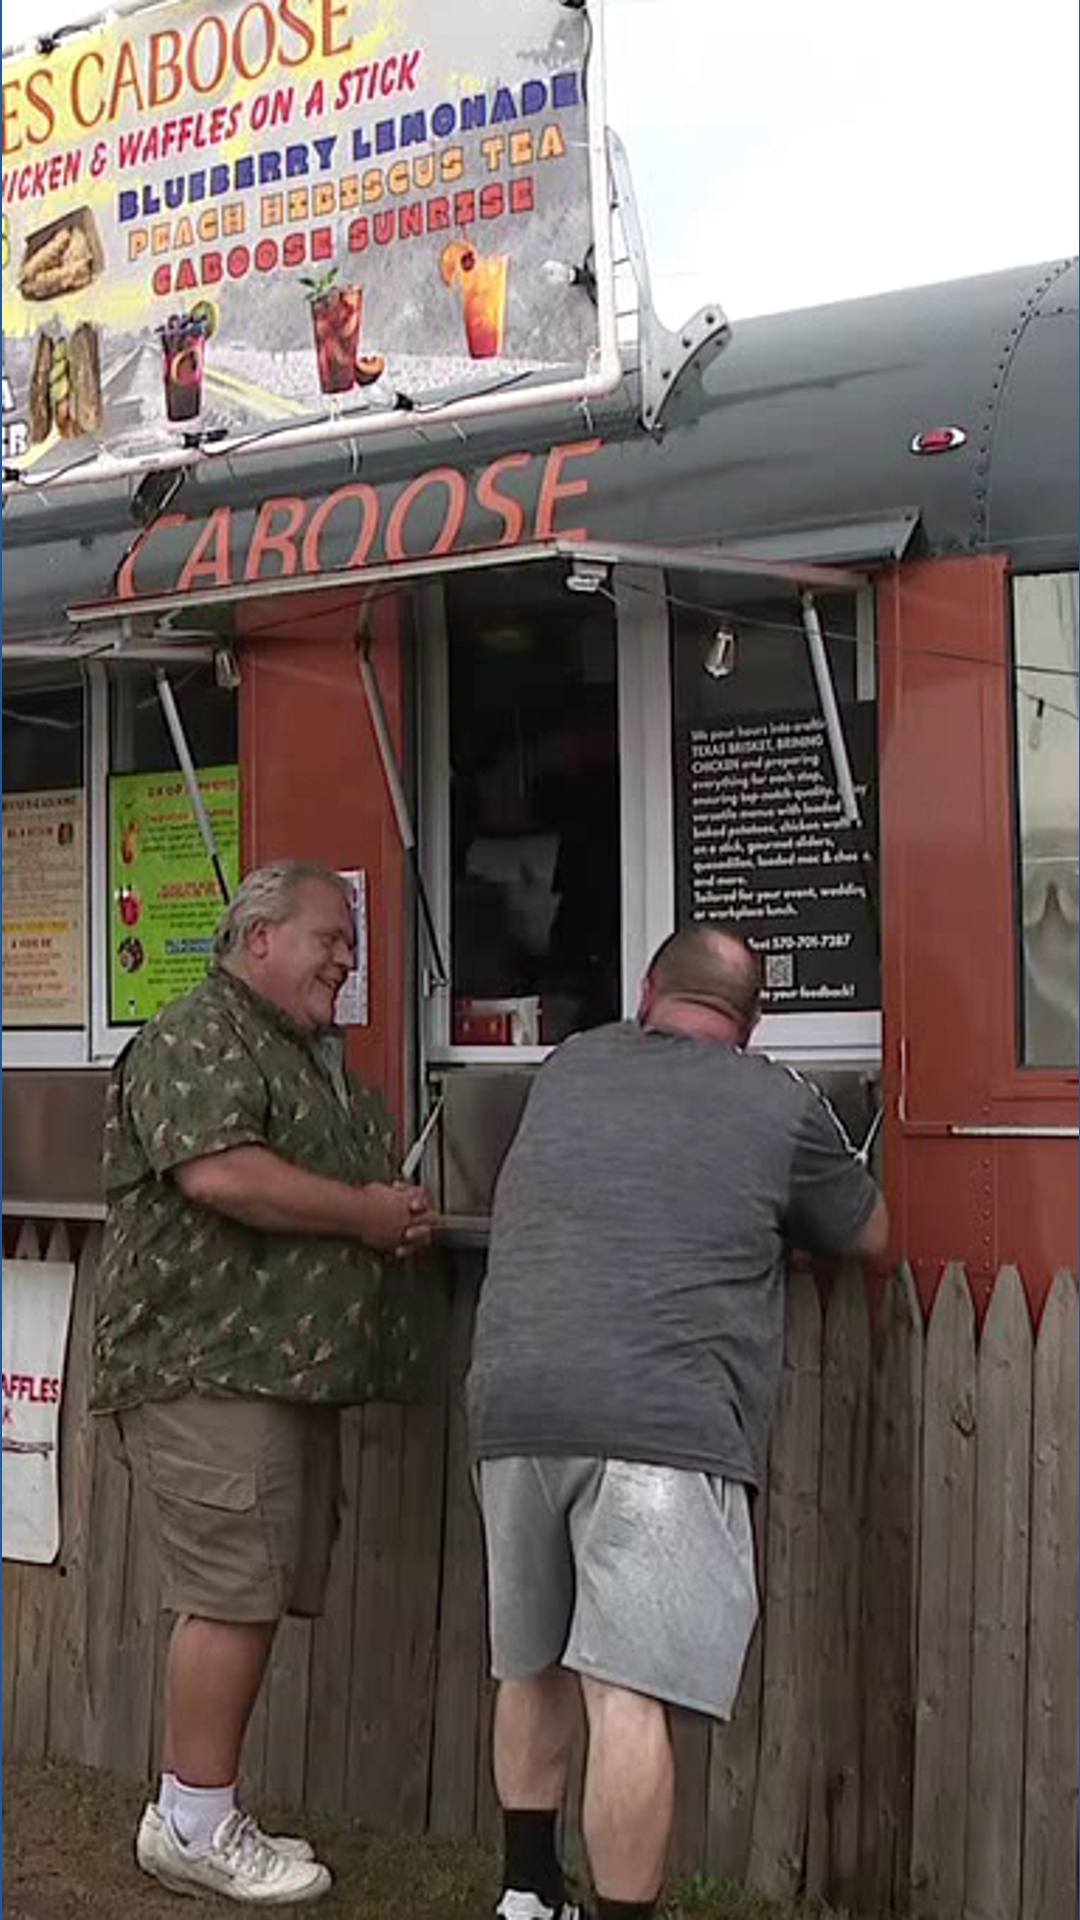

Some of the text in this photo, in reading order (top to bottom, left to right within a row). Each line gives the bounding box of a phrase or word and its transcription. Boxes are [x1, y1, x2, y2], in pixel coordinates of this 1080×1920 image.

[70, 0, 353, 128] CABOOSE
[90, 142, 107, 178] &
[118, 102, 243, 169] WAFFLES
[249, 87, 294, 131] ON
[305, 79, 324, 118] A
[335, 50, 420, 110] STICK
[119, 72, 578, 222] BLUEBERRY LEMONADE
[129, 123, 565, 261] PEACH HIBISCUS TEA
[153, 176, 534, 295] CABOOSE SUNRISE
[114, 437, 604, 600] CABOOSE
[691, 742, 725, 756] TEXAS
[691, 759, 739, 773] CHICKEN
[741, 756, 762, 769] and
[693, 874, 714, 888] and
